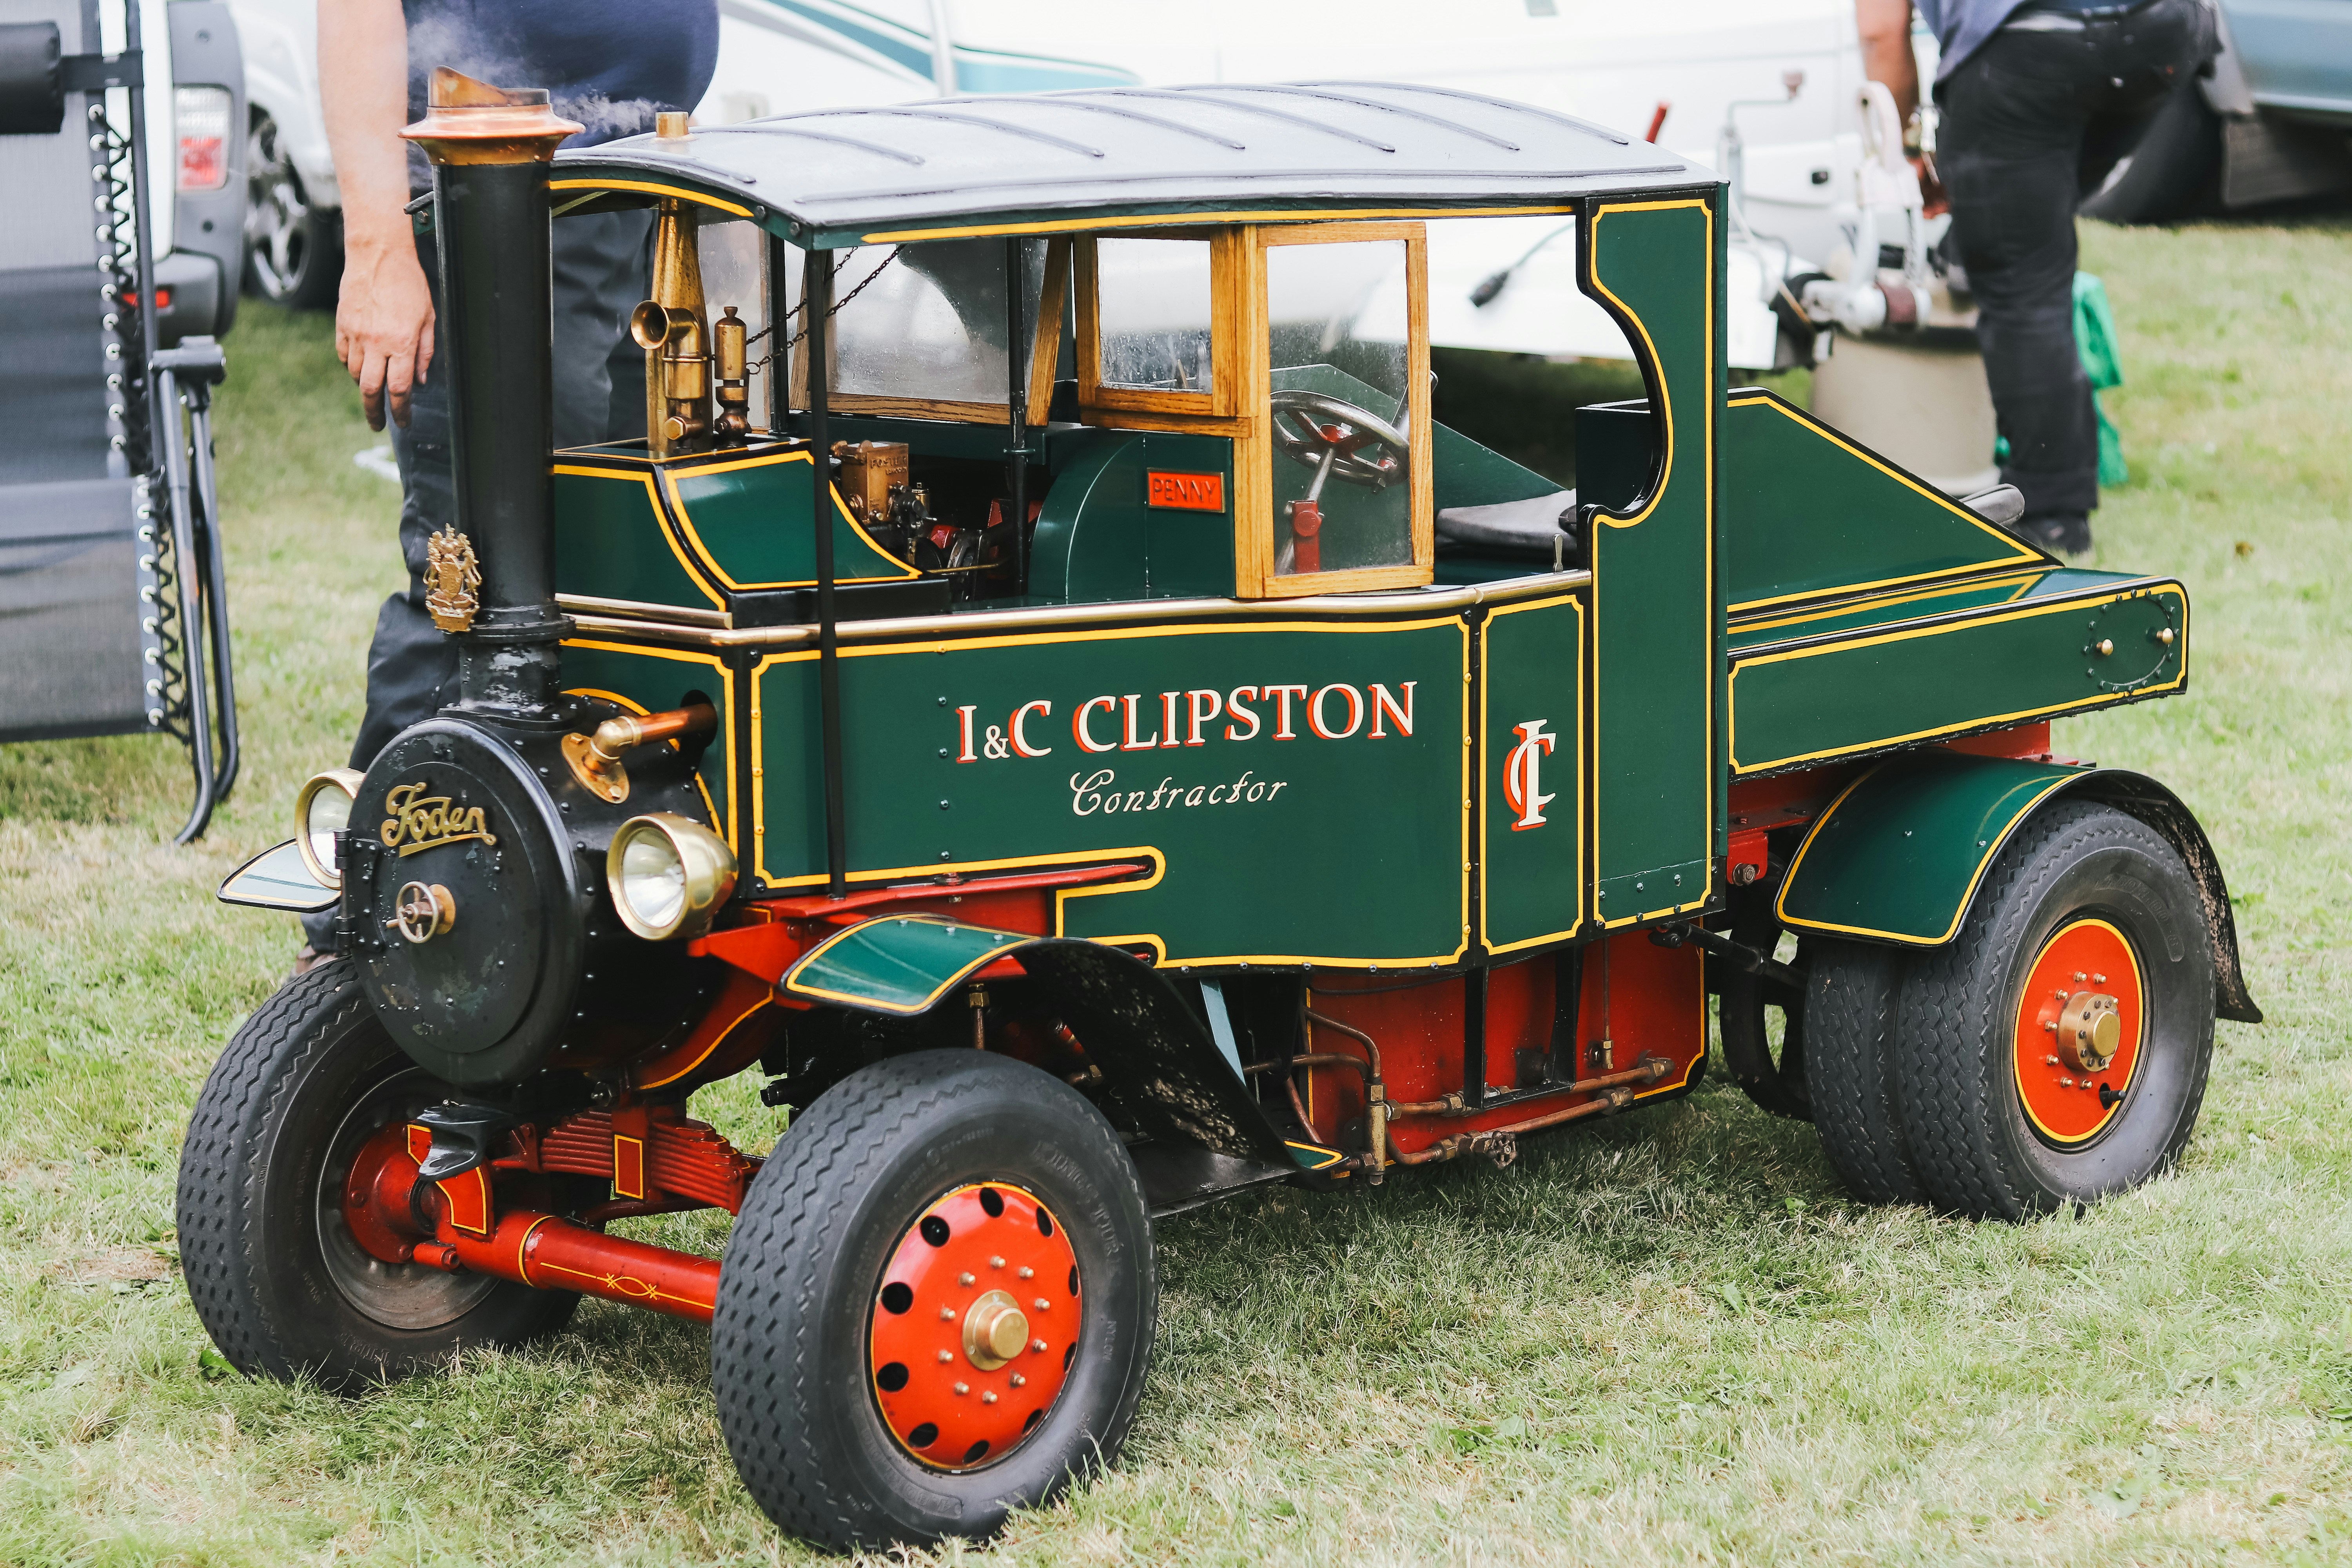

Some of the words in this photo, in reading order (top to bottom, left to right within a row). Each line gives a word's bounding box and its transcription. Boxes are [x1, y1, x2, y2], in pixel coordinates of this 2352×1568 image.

[1154, 477, 1216, 503] PENNY
[955, 700, 1052, 763] I&C
[1072, 681, 1417, 753] CLIPSTON
[381, 782, 497, 858] Foden
[1070, 769, 1287, 816] Contractor
